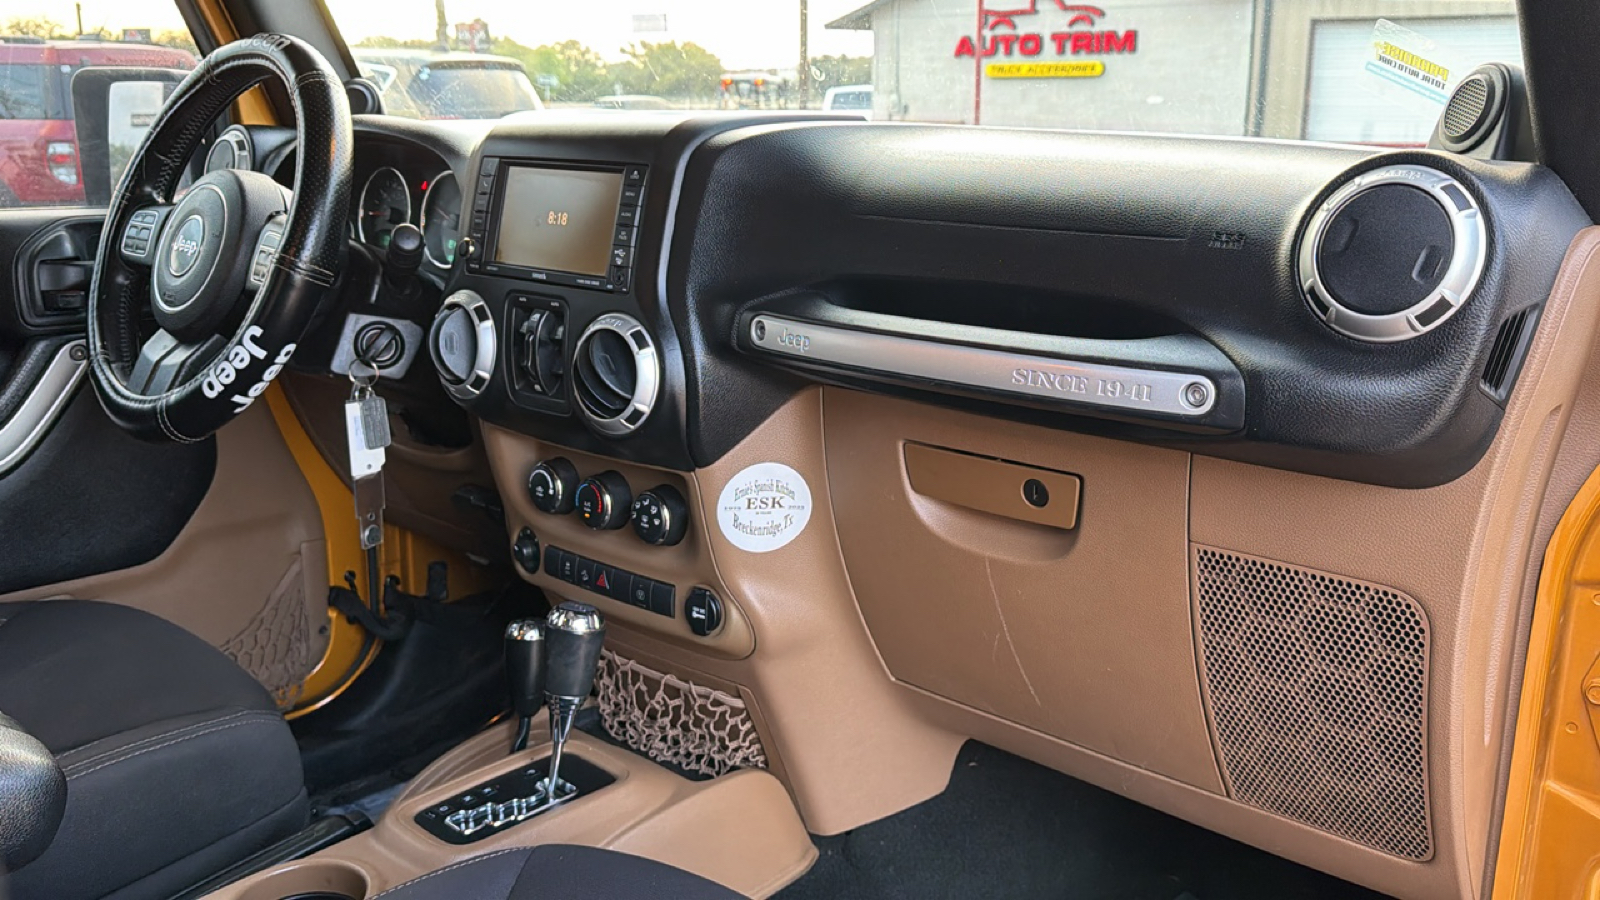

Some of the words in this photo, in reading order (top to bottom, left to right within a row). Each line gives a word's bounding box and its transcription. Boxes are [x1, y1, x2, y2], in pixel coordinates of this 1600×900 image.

[954, 33, 1042, 58] AUTO
[1051, 30, 1136, 55] TRIM
[547, 211, 569, 226] 8:18
[172, 233, 198, 256] Jeep
[777, 327, 810, 352] Jeep
[201, 324, 268, 400] Jeep
[1011, 368, 1089, 394] SINCE
[1097, 379, 1152, 402] 1941
[754, 478, 774, 496] Spanish
[745, 495, 786, 510] ESK
